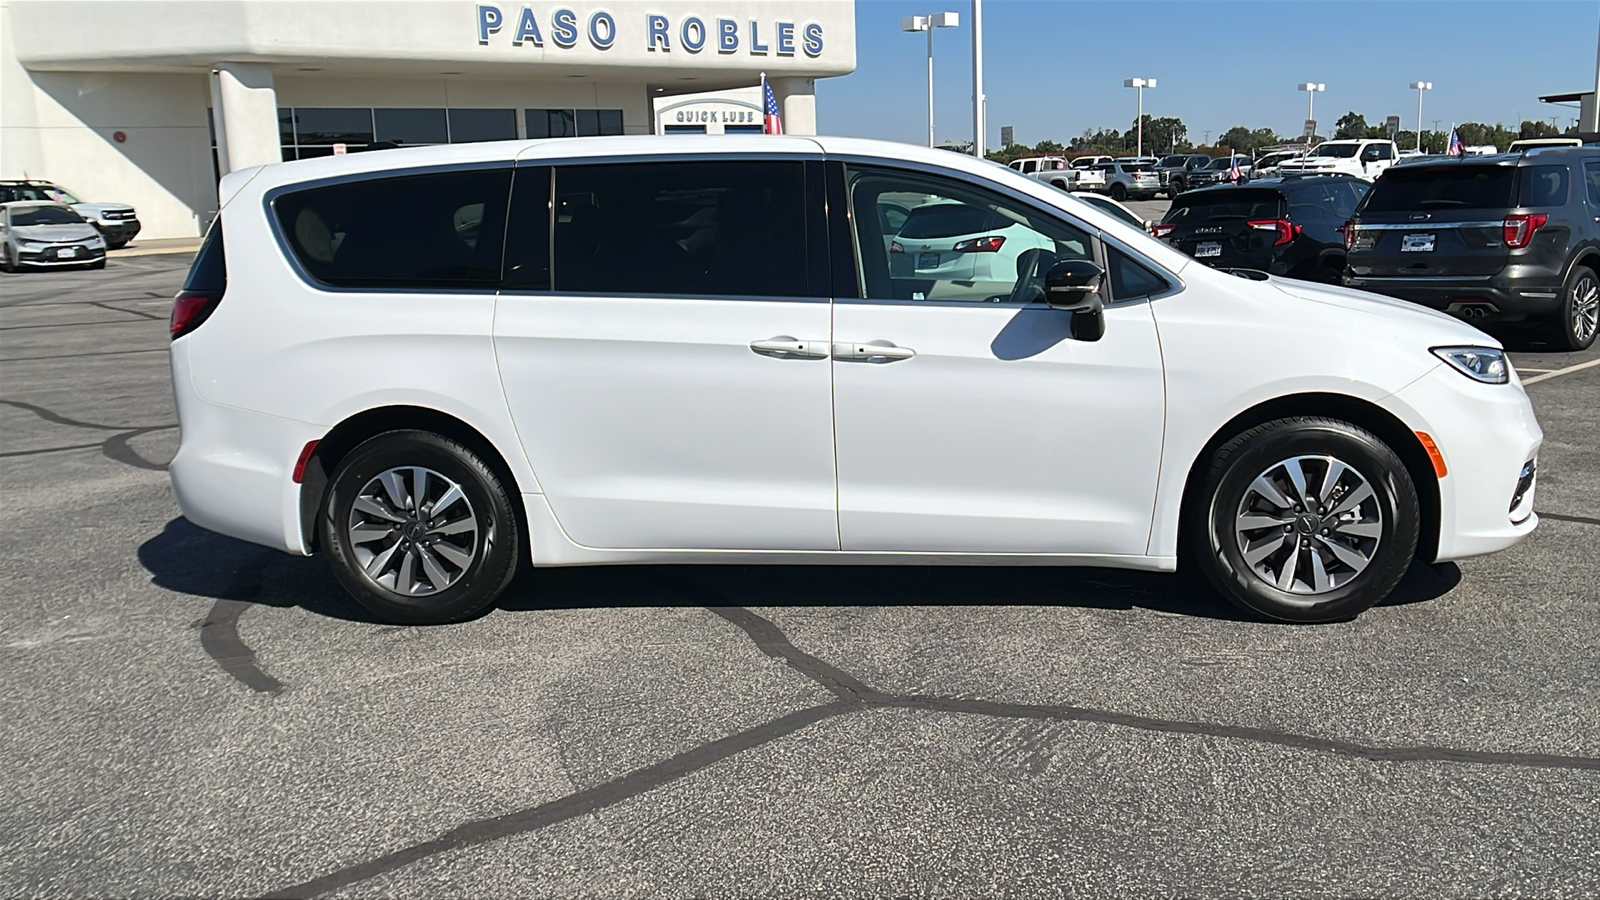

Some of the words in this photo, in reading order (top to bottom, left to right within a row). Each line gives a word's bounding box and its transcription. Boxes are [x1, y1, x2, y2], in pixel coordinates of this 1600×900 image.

[477, 4, 616, 49] PASO
[647, 14, 823, 57] ROBLES
[676, 110, 718, 123] QUICK
[722, 111, 754, 122] LUBE
